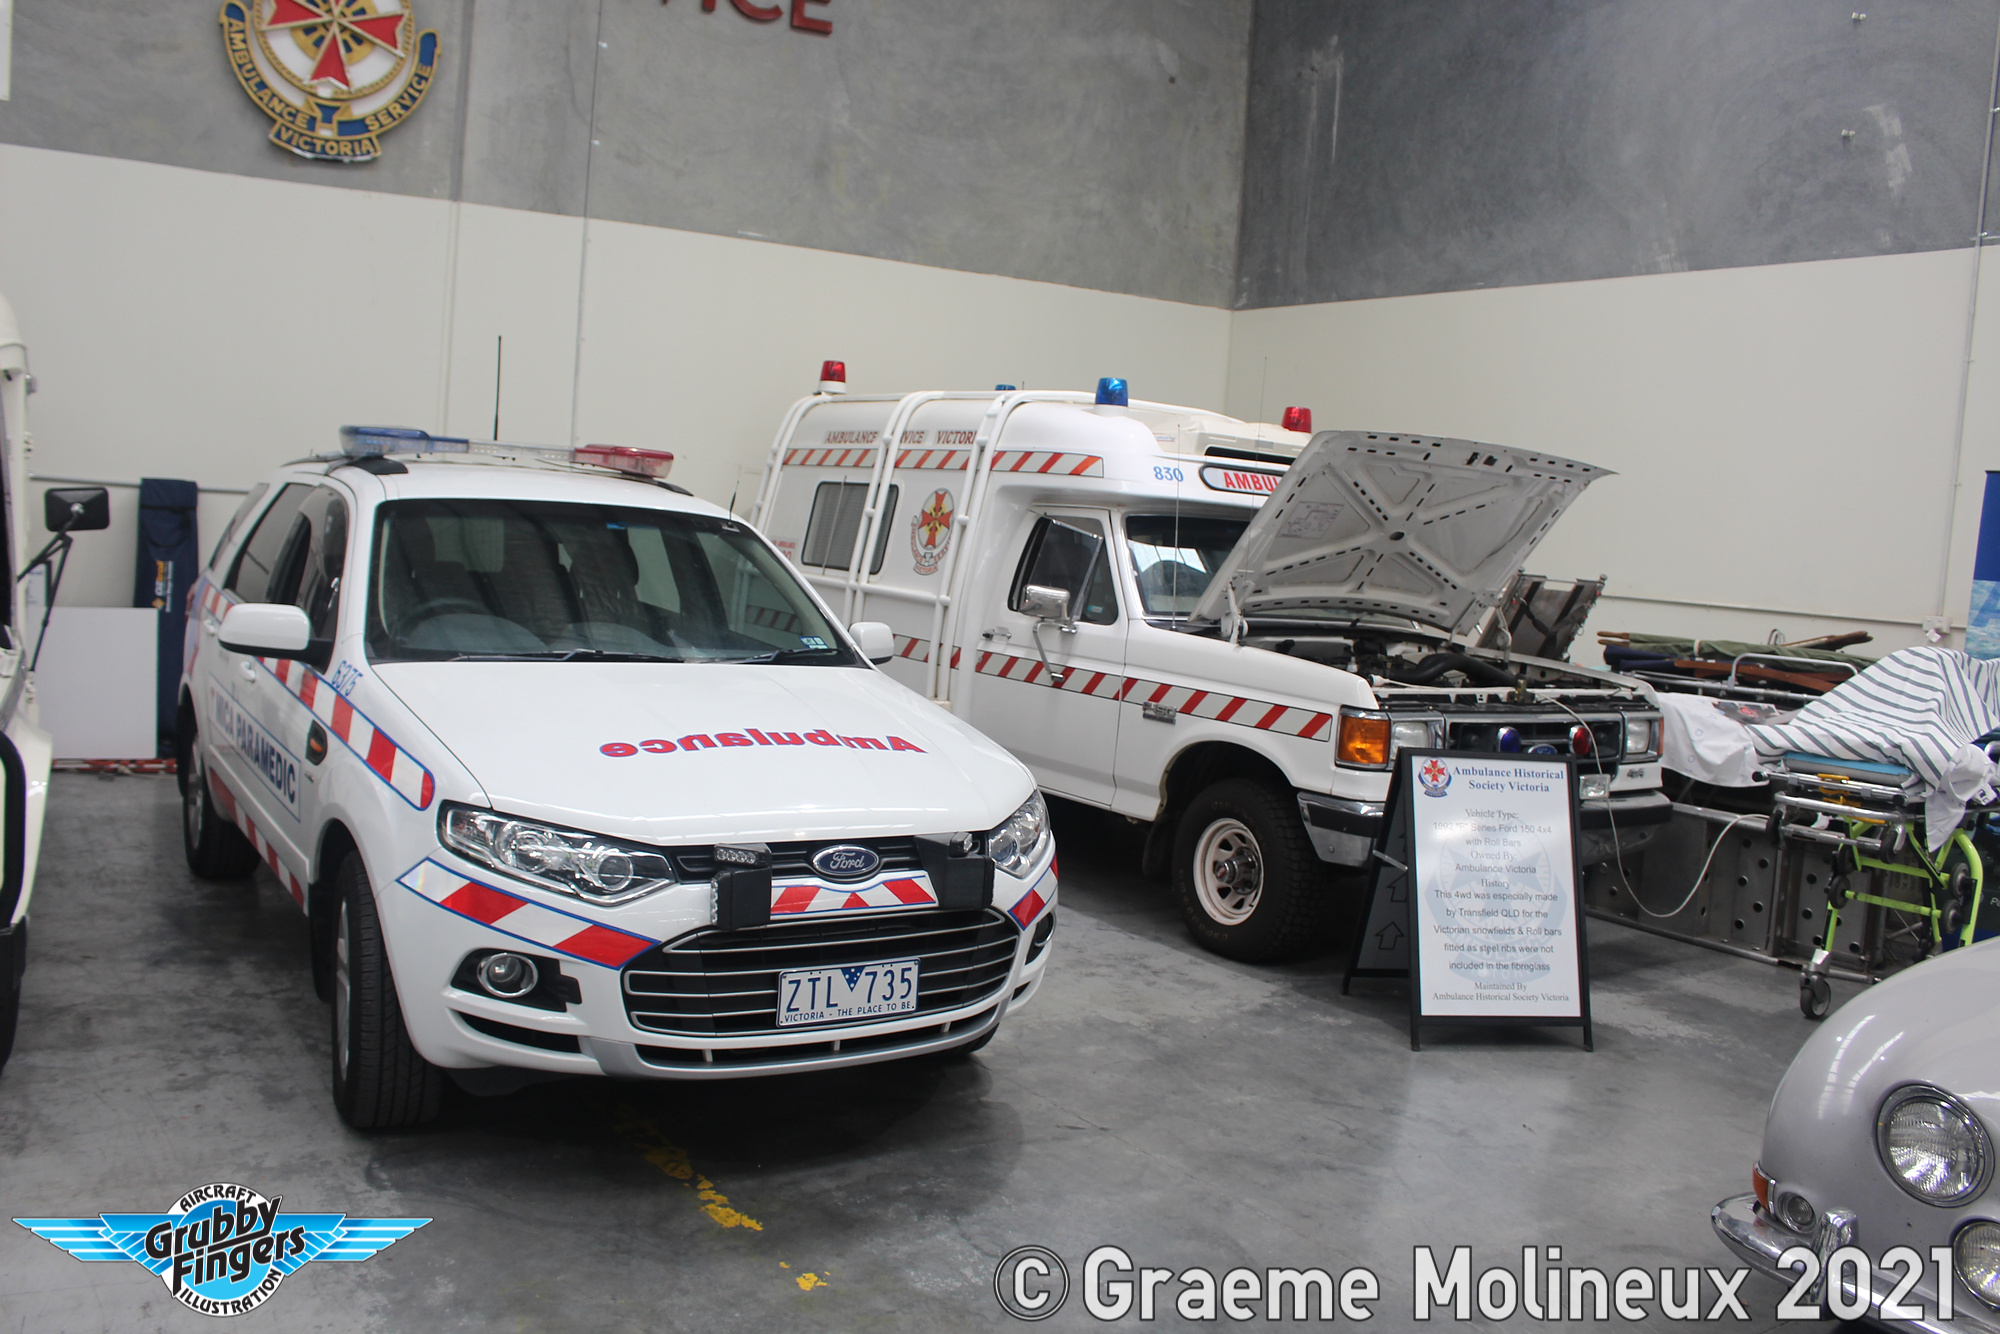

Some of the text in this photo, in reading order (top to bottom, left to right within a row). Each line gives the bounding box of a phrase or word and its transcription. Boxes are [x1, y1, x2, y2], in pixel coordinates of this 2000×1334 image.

[227, 15, 432, 132] AMBULANCE SERVICE
[278, 125, 376, 157] VICTORIA
[824, 431, 879, 445] AMBULANCE
[1153, 465, 1185, 483] 830
[331, 659, 364, 698] 6375
[215, 692, 296, 805] MICA PARAMEDIC
[1453, 766, 1564, 780] Ambulance Historical
[1468, 780, 1550, 792] Society Victoria
[1465, 808, 1519, 820] Vehicle Type:
[1471, 823, 1497, 832] Series
[1499, 824, 1518, 832] Ford
[1520, 825, 1535, 833] 150
[1537, 826, 1552, 834] 4x4
[1465, 837, 1521, 847] with Roll Bars
[828, 850, 867, 872] Ford
[1470, 850, 1518, 862] Owned By:
[1455, 863, 1537, 874] Ambulance Victoria
[1481, 878, 1510, 890] History
[1434, 889, 1558, 902] This 4wd was especially made
[1446, 908, 1548, 918] by Transfield QLD for the
[1433, 925, 1562, 936] Victorian snowfields & Roll bars
[1444, 943, 1465, 952] fitted
[1501, 944, 1516, 952] ribs
[1540, 945, 1554, 953] not
[1449, 961, 1550, 972] included in the fibreglass
[786, 966, 913, 1013] ZTL 735
[1474, 982, 1527, 992] Maintained By
[1433, 992, 1569, 1002] Ambulance Historical Society Victoria
[784, 1011, 825, 1023] VICTORIA
[837, 1007, 853, 1017] THE
[857, 1004, 882, 1015] PLACE
[886, 1002, 897, 1012] TO
